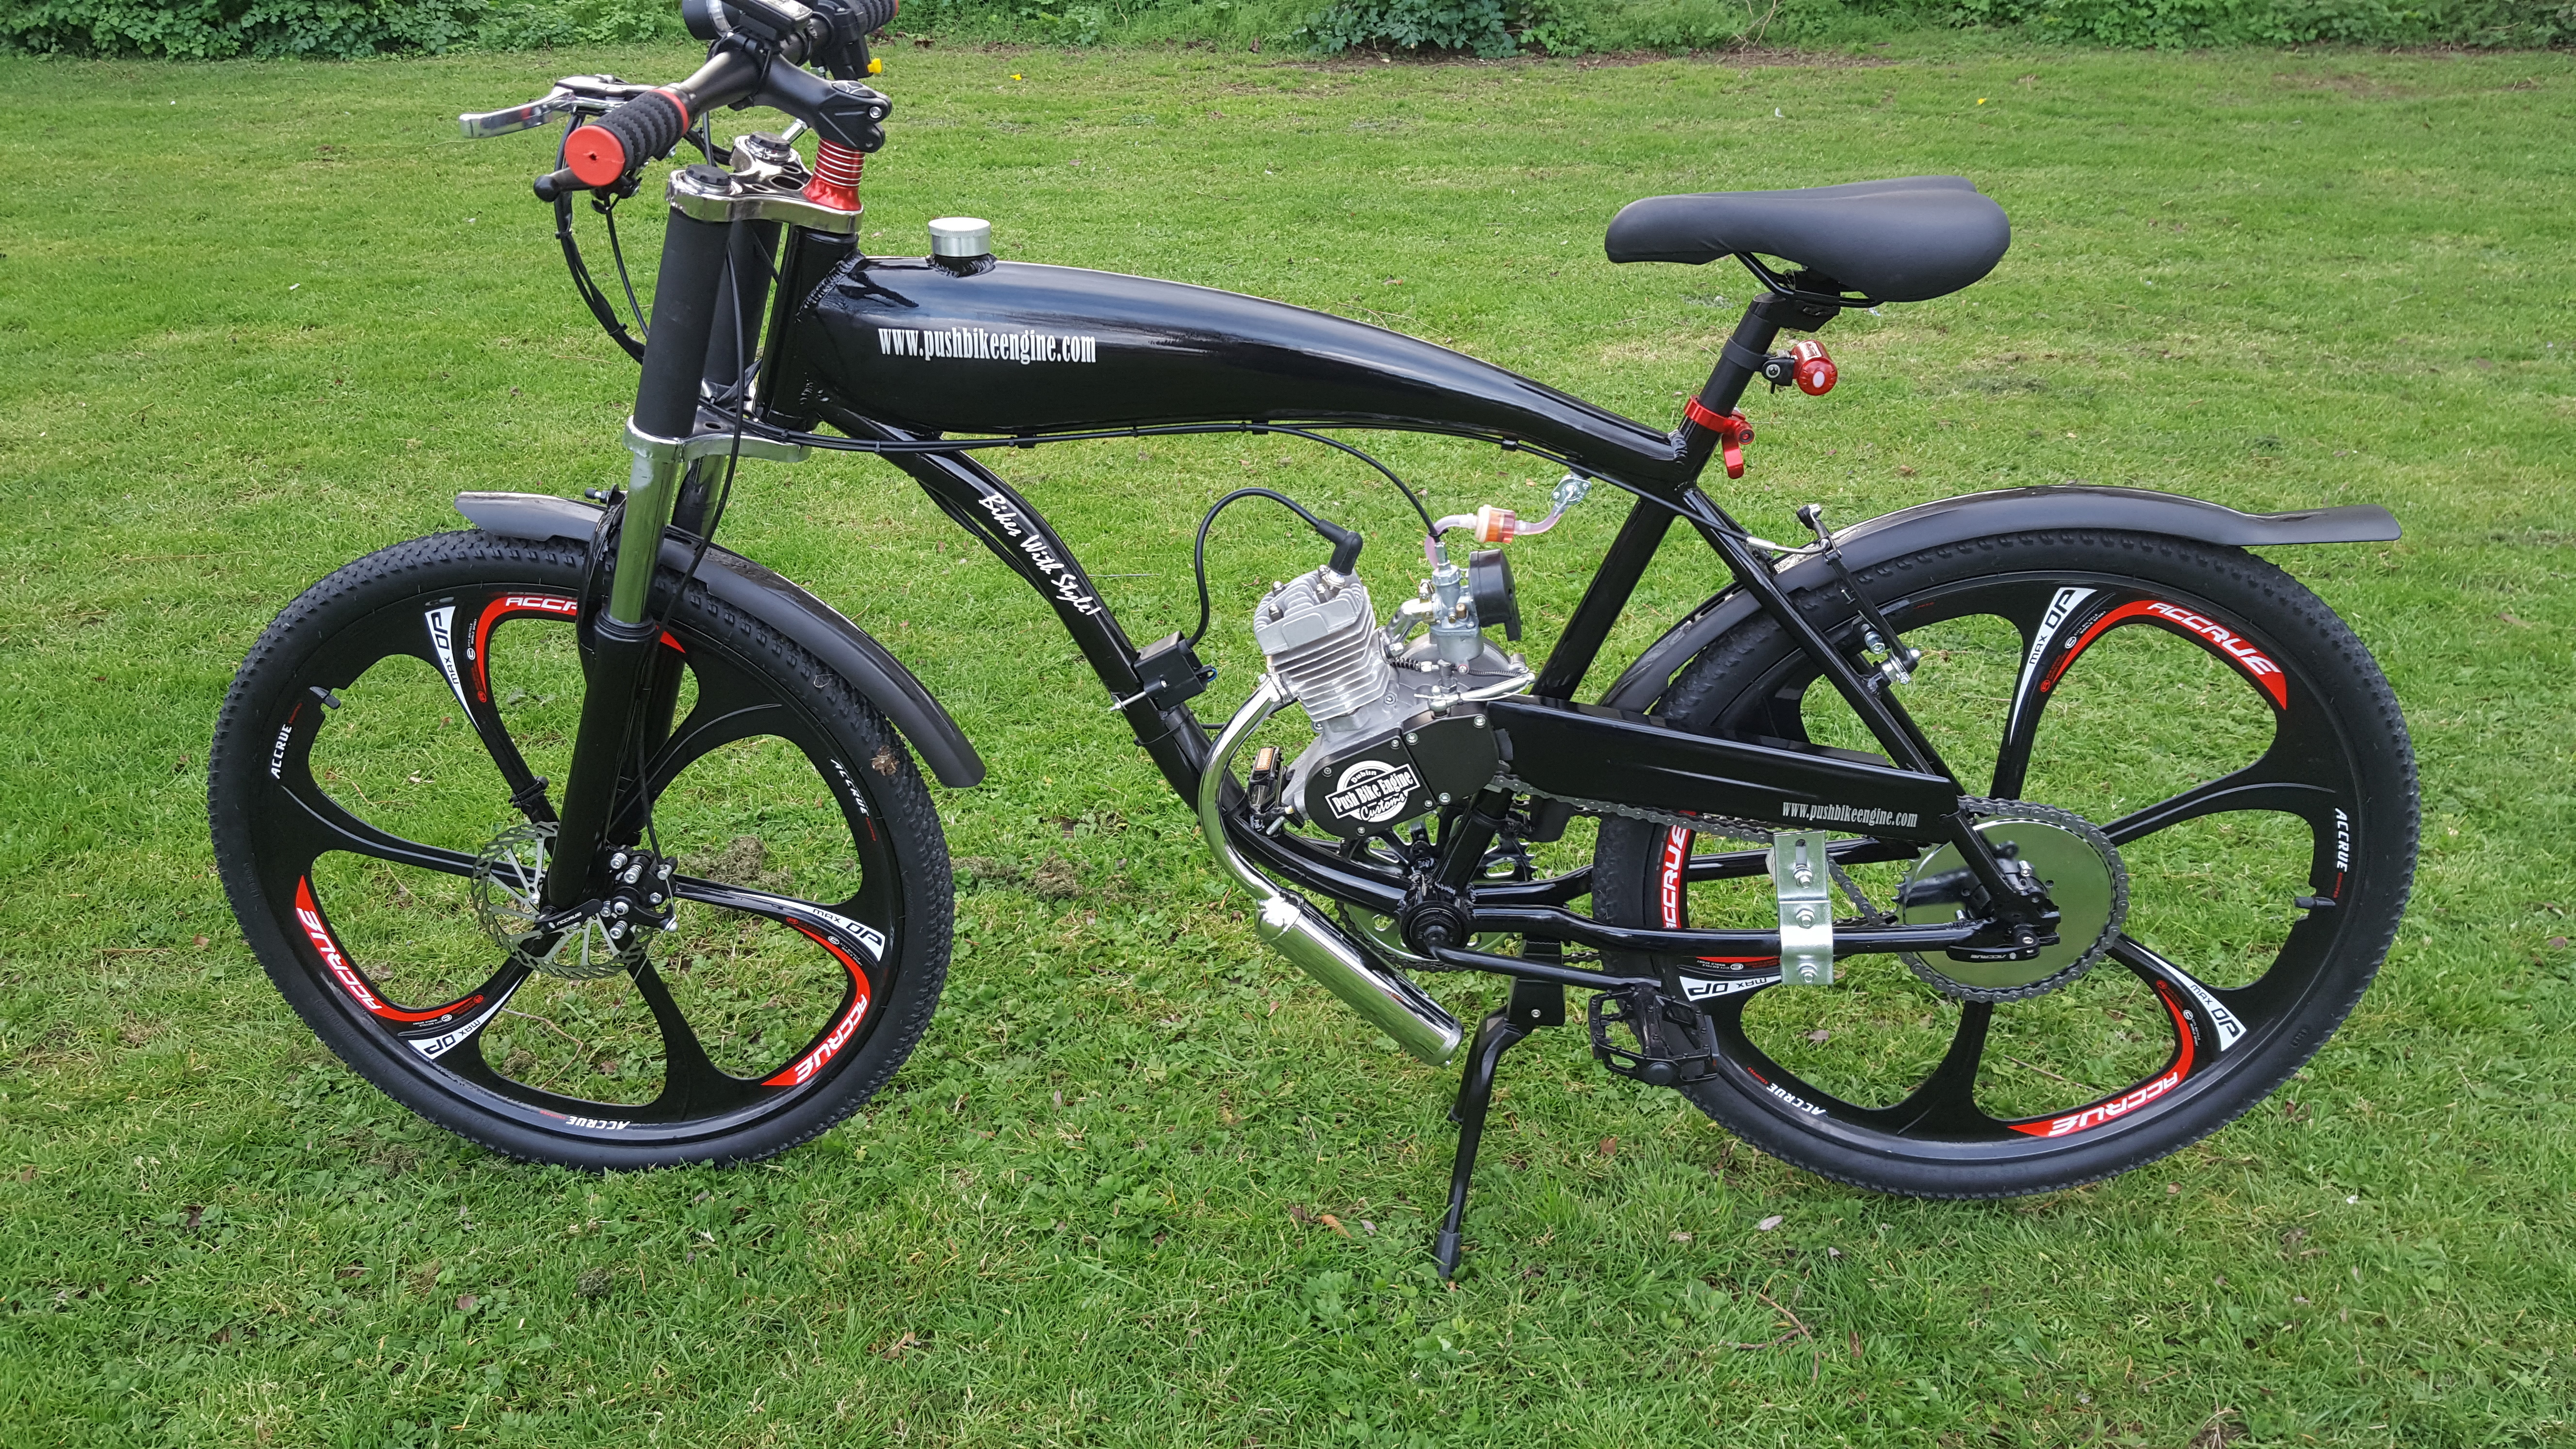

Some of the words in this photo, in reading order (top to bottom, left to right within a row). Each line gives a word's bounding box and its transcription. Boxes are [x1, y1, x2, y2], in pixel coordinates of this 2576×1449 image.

[878, 327, 1096, 365] www.pushbikeengine.com
[979, 492, 1021, 537] Bikes
[1020, 534, 1064, 575] With
[2029, 635, 2048, 665] MAX
[2147, 602, 2282, 675] ACCRUE
[444, 656, 459, 684] MAX
[271, 724, 292, 779] ACCRUE
[831, 759, 869, 817] ACCRUE
[1332, 791, 1358, 812] Push
[1355, 782, 1381, 804] Bike
[1378, 771, 1413, 792] Engine
[1351, 770, 1377, 784] Dublin
[1361, 794, 1405, 821] Customs
[1783, 802, 1917, 827] www.pushbikeengine.com
[2335, 807, 2349, 872] ACCRUE
[557, 912, 582, 926] ACCRUE
[813, 908, 840, 923] MAX
[296, 908, 382, 1010] ACCRUE
[1736, 978, 1767, 988] MAX
[2190, 984, 2213, 1005] MAX
[458, 1019, 481, 1036] MAX
[795, 994, 867, 1083] ACCRUE
[1766, 1082, 1826, 1115] ACCRUE
[2048, 1072, 2178, 1136] ACCRUE
[566, 1116, 630, 1129] ACCRUE
